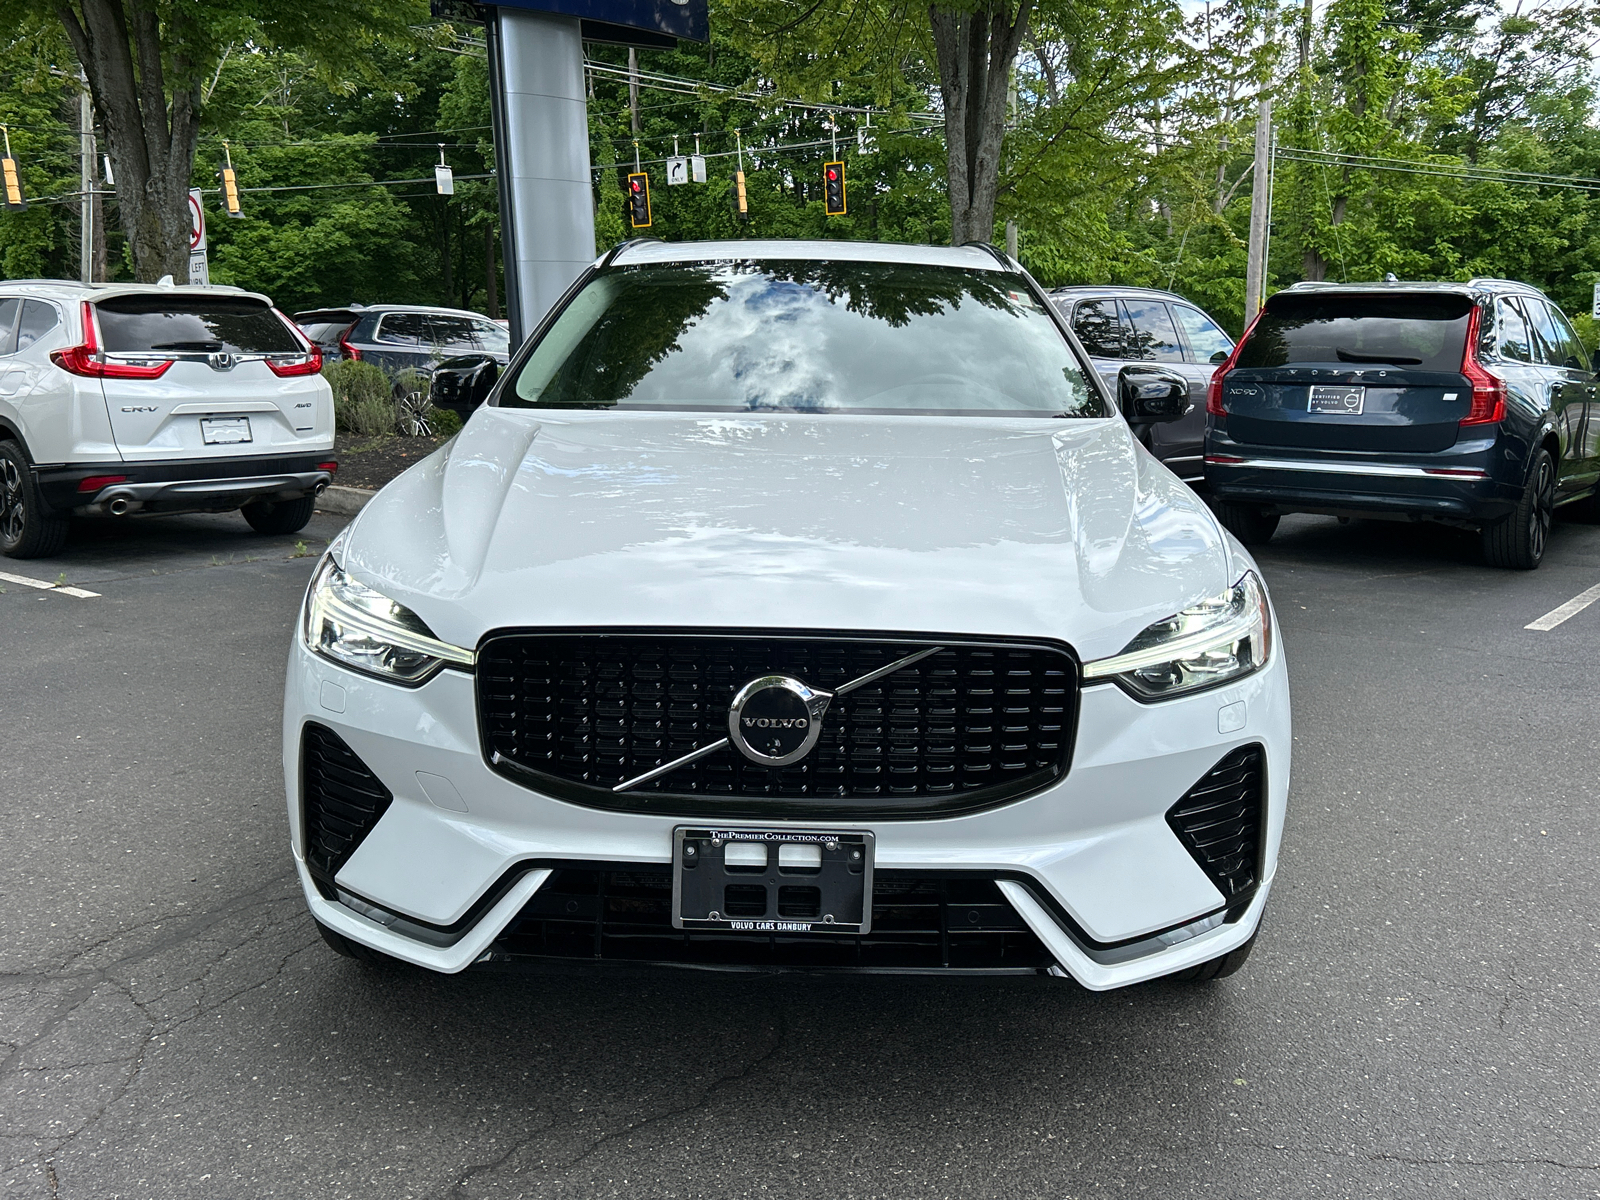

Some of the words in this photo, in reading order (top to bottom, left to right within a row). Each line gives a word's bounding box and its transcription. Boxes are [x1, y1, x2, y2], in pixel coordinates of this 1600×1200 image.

[191, 262, 205, 273] LEFT
[1289, 369, 1387, 377] VOLVO
[1229, 388, 1258, 396] XC90
[742, 717, 808, 729] VOLVO
[731, 921, 754, 930] VOLVO
[756, 922, 775, 930] CARS
[777, 923, 812, 931] DANBURY
